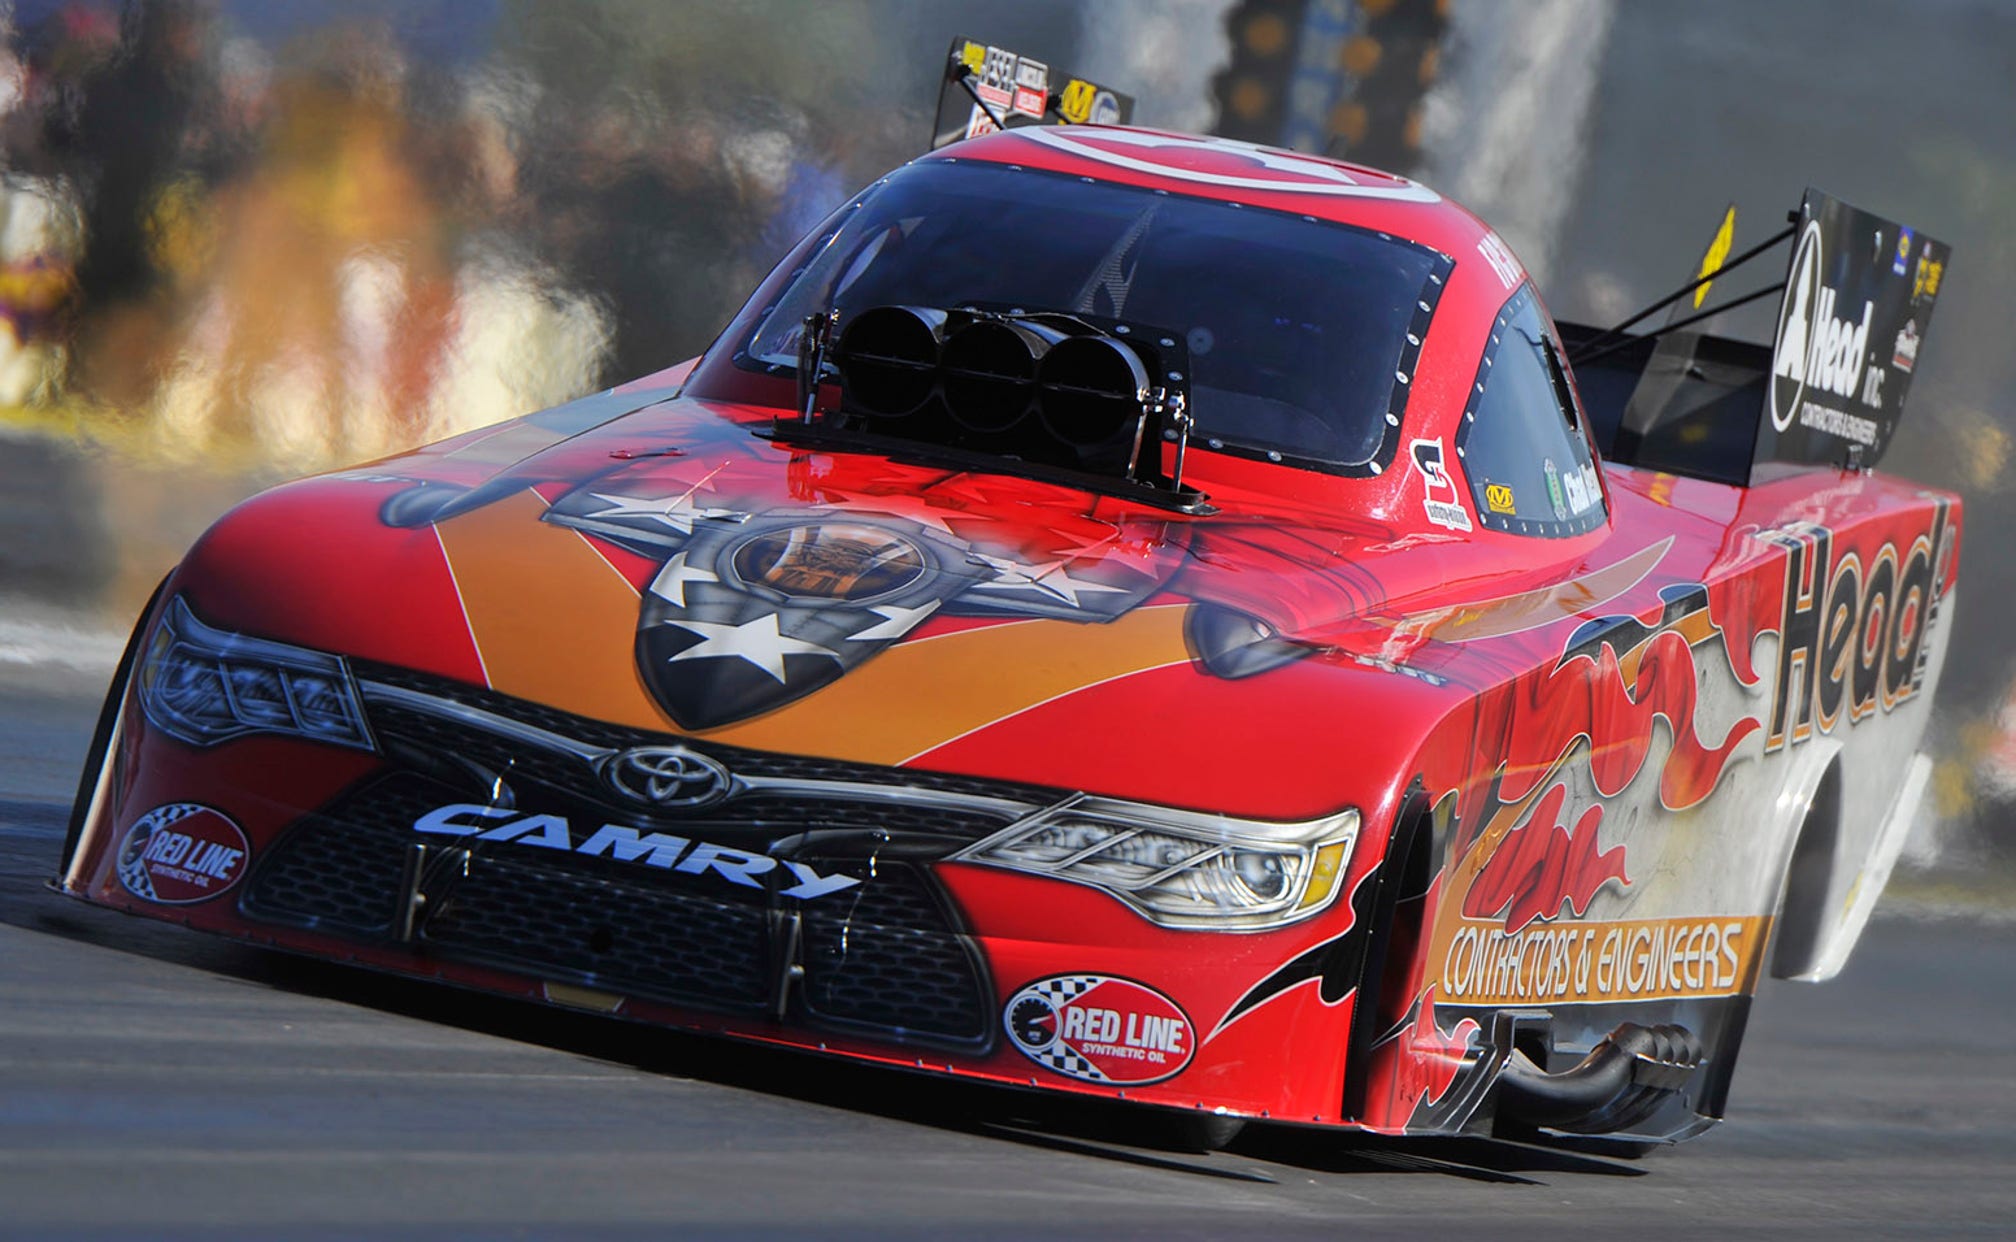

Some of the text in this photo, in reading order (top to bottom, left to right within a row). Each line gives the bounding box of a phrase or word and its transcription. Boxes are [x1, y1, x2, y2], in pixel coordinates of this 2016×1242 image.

[1806, 286, 1873, 398] Head
[1765, 496, 1951, 752] Head
[145, 830, 244, 880] RED LINE
[151, 863, 210, 888] SYNTHETIC OIL
[413, 803, 863, 900] CAMRY
[1444, 922, 1741, 997] CONTRACTORS & ENGINEERS
[1063, 1006, 1185, 1054] RED LINE
[1082, 1042, 1166, 1064] SYNTHETIC OIL
